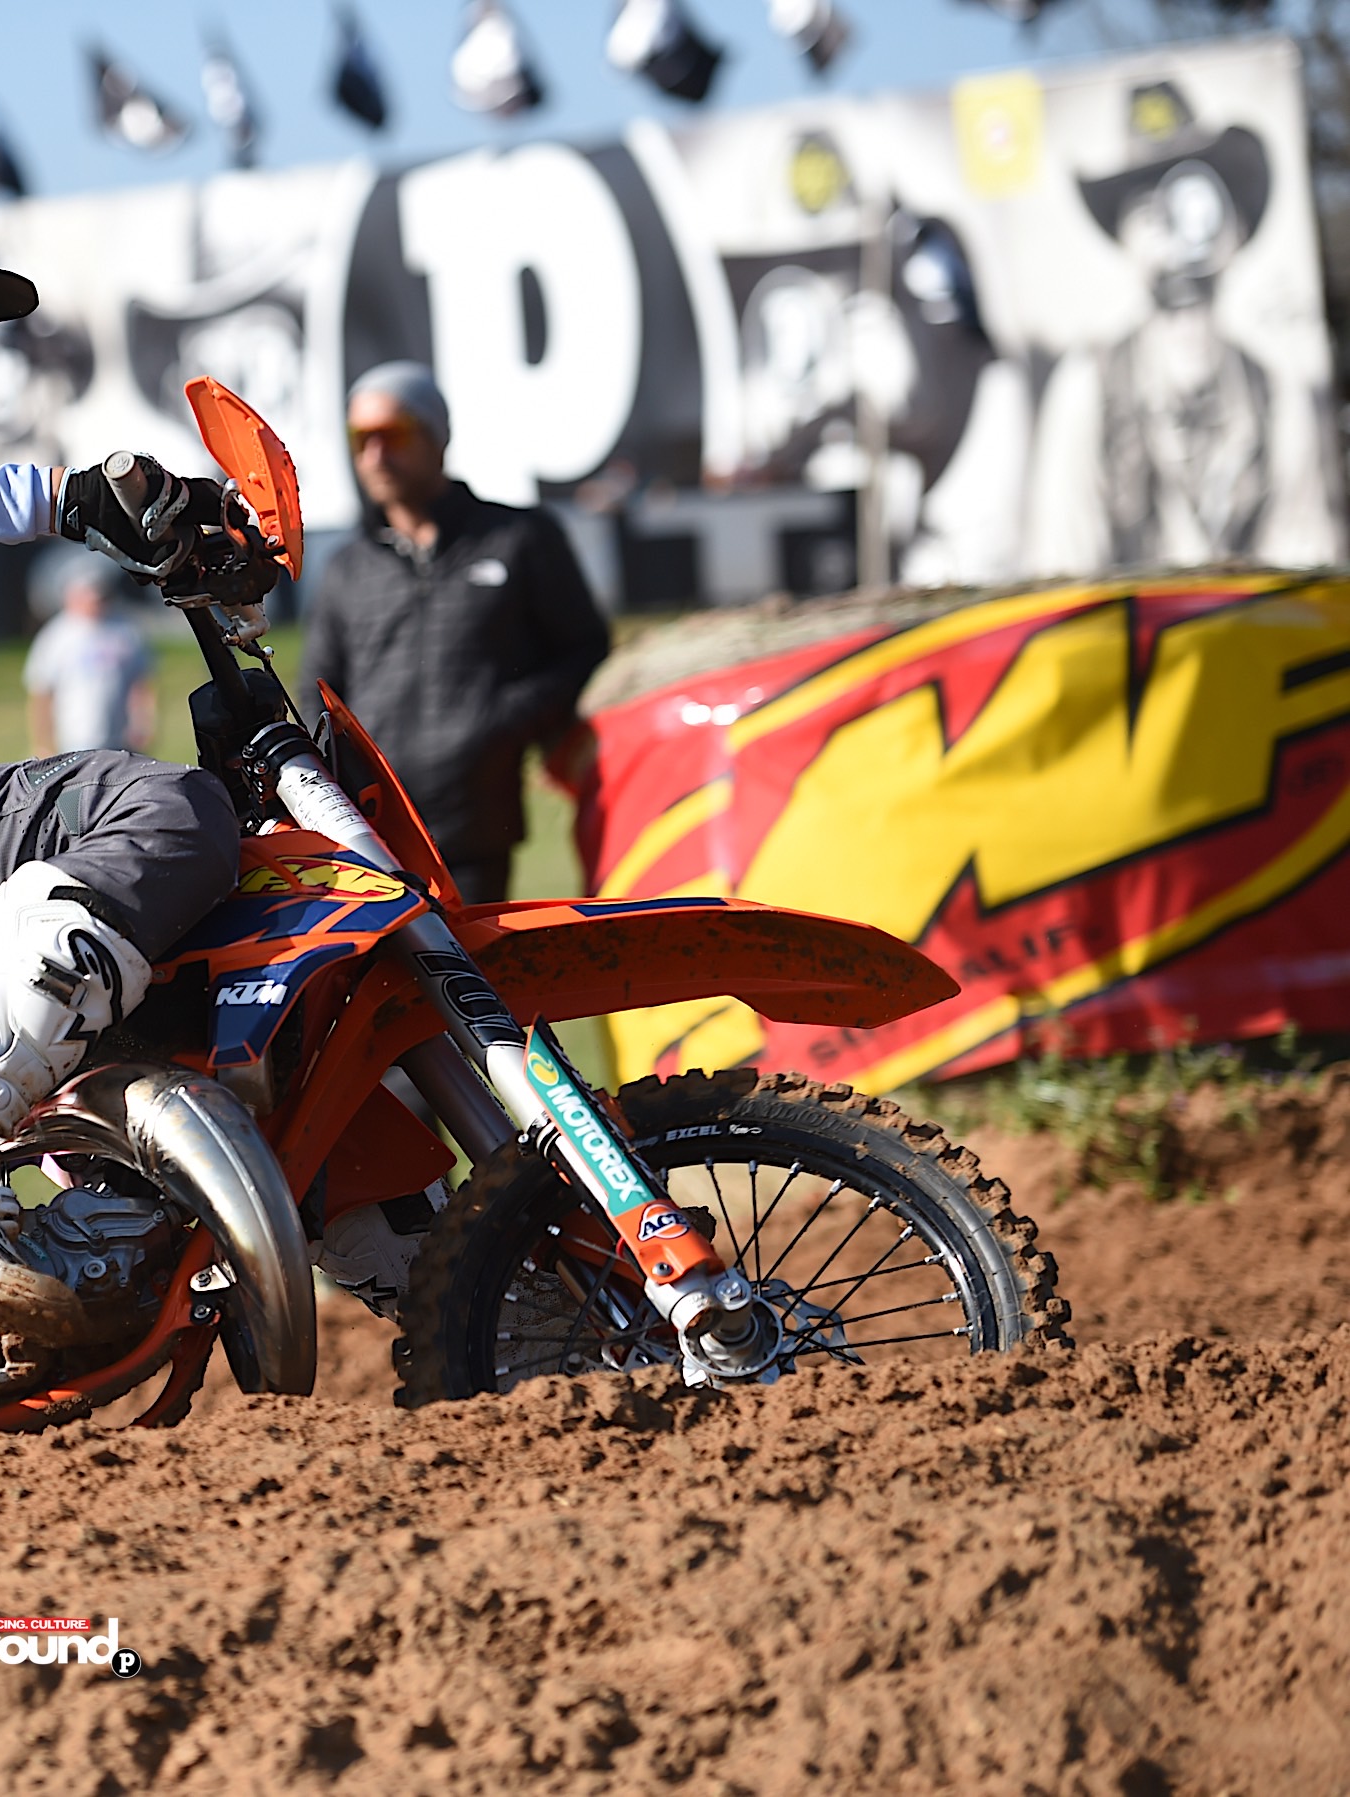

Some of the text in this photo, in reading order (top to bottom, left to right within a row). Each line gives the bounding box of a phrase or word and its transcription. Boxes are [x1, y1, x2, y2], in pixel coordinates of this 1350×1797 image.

[240, 863, 406, 895] FMF
[214, 980, 288, 1007] KTM
[546, 1083, 646, 1203] MOTOREX
[665, 1124, 722, 1142] EXCEL
